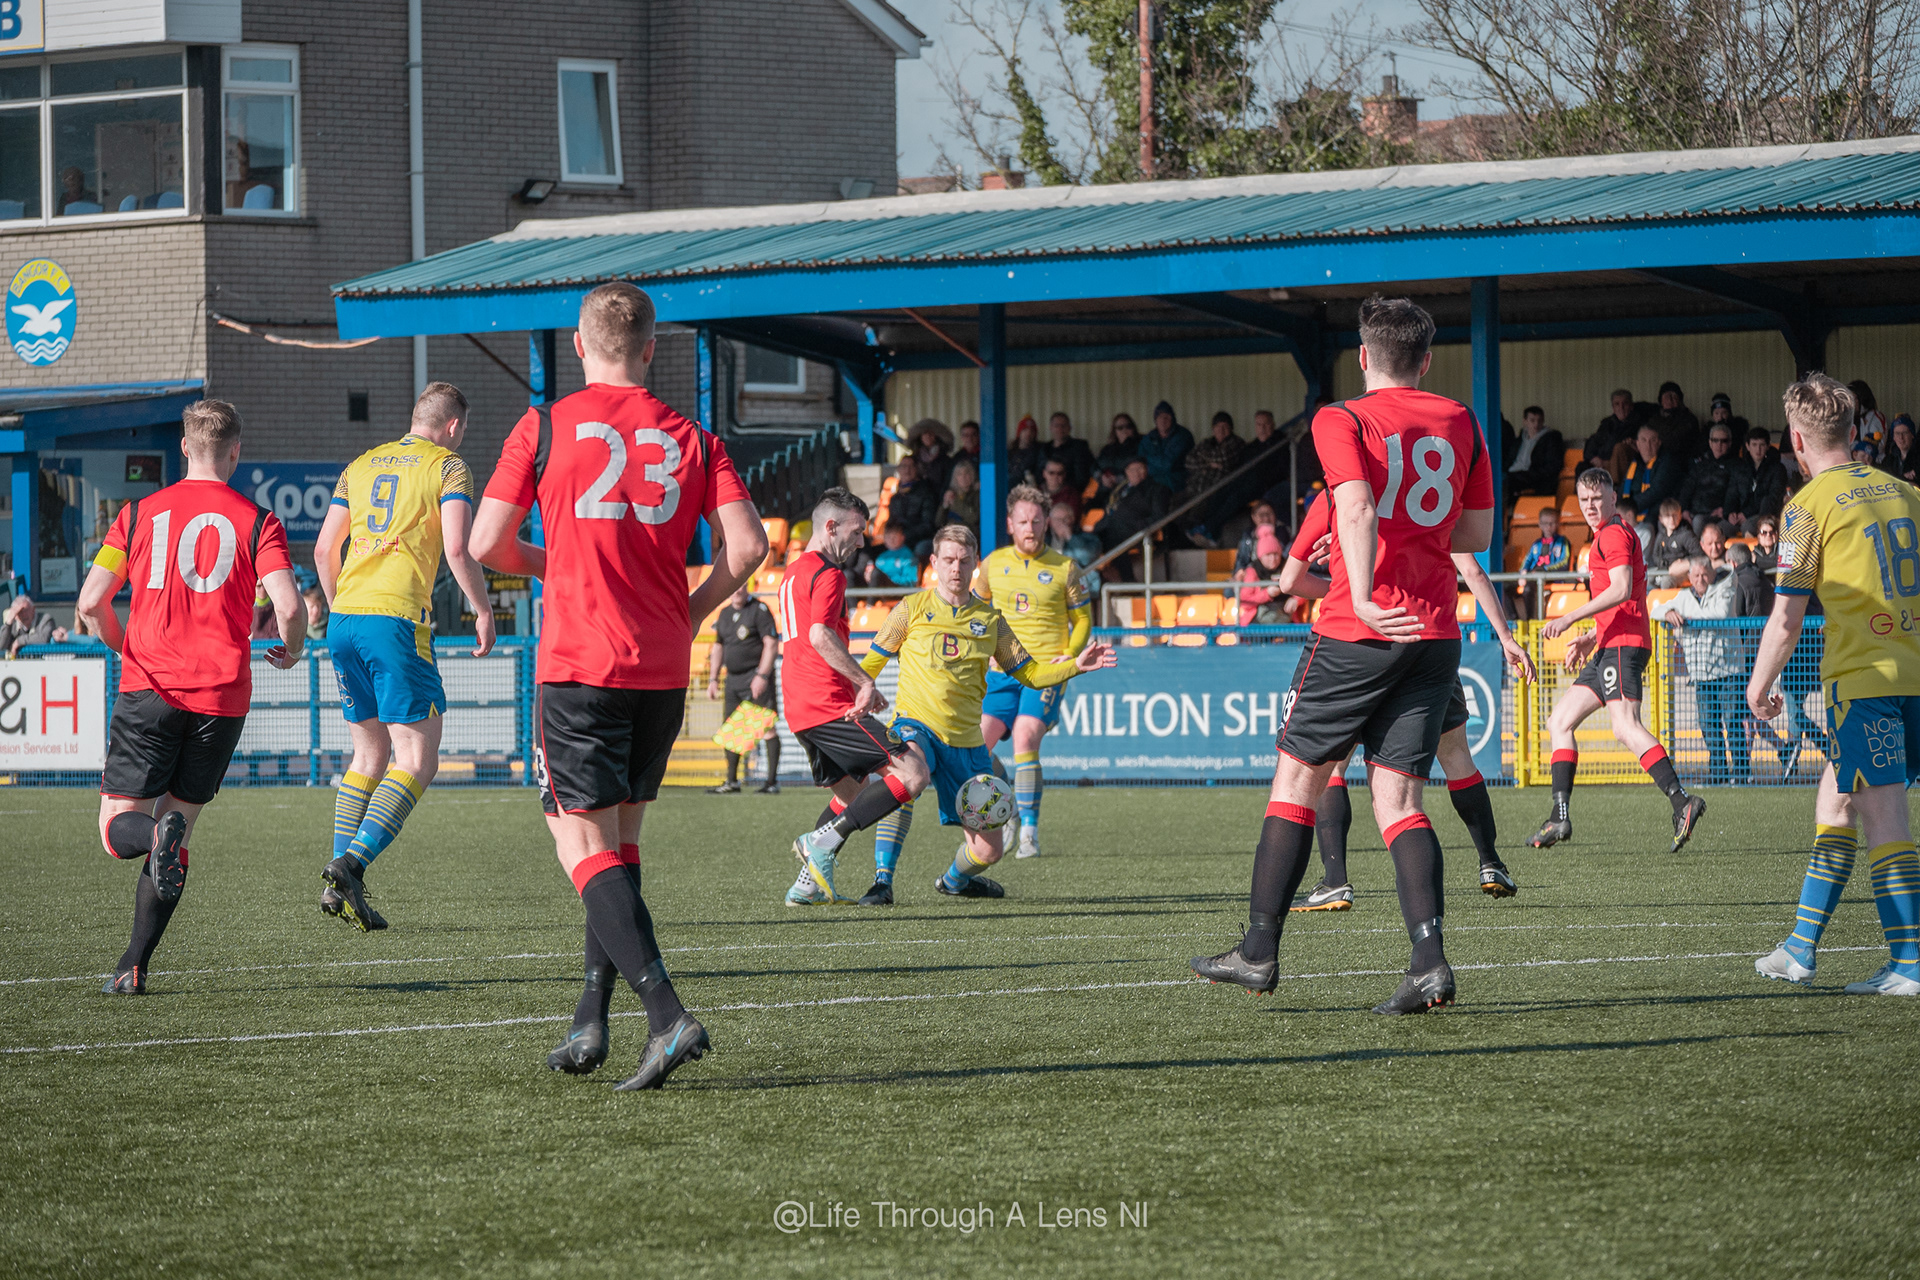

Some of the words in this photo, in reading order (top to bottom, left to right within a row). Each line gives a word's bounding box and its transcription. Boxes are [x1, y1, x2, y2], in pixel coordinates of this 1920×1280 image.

[12, 262, 49, 293] BANGOR
[575, 421, 681, 524] 23
[1376, 432, 1455, 527] 18
[367, 474, 399, 533] 9
[147, 509, 236, 593] 10
[382, 536, 399, 552] H
[1864, 517, 1920, 600] 18
[780, 575, 798, 643] 11
[1016, 593, 1029, 611] B
[1869, 612, 1893, 636] G
[1901, 610, 1913, 631] &
[943, 633, 959, 657] B
[1603, 666, 1617, 688] 9
[0, 677, 26, 735] &
[41, 676, 78, 735] H
[24, 742, 61, 754] Services
[65, 742, 78, 754] Ltd
